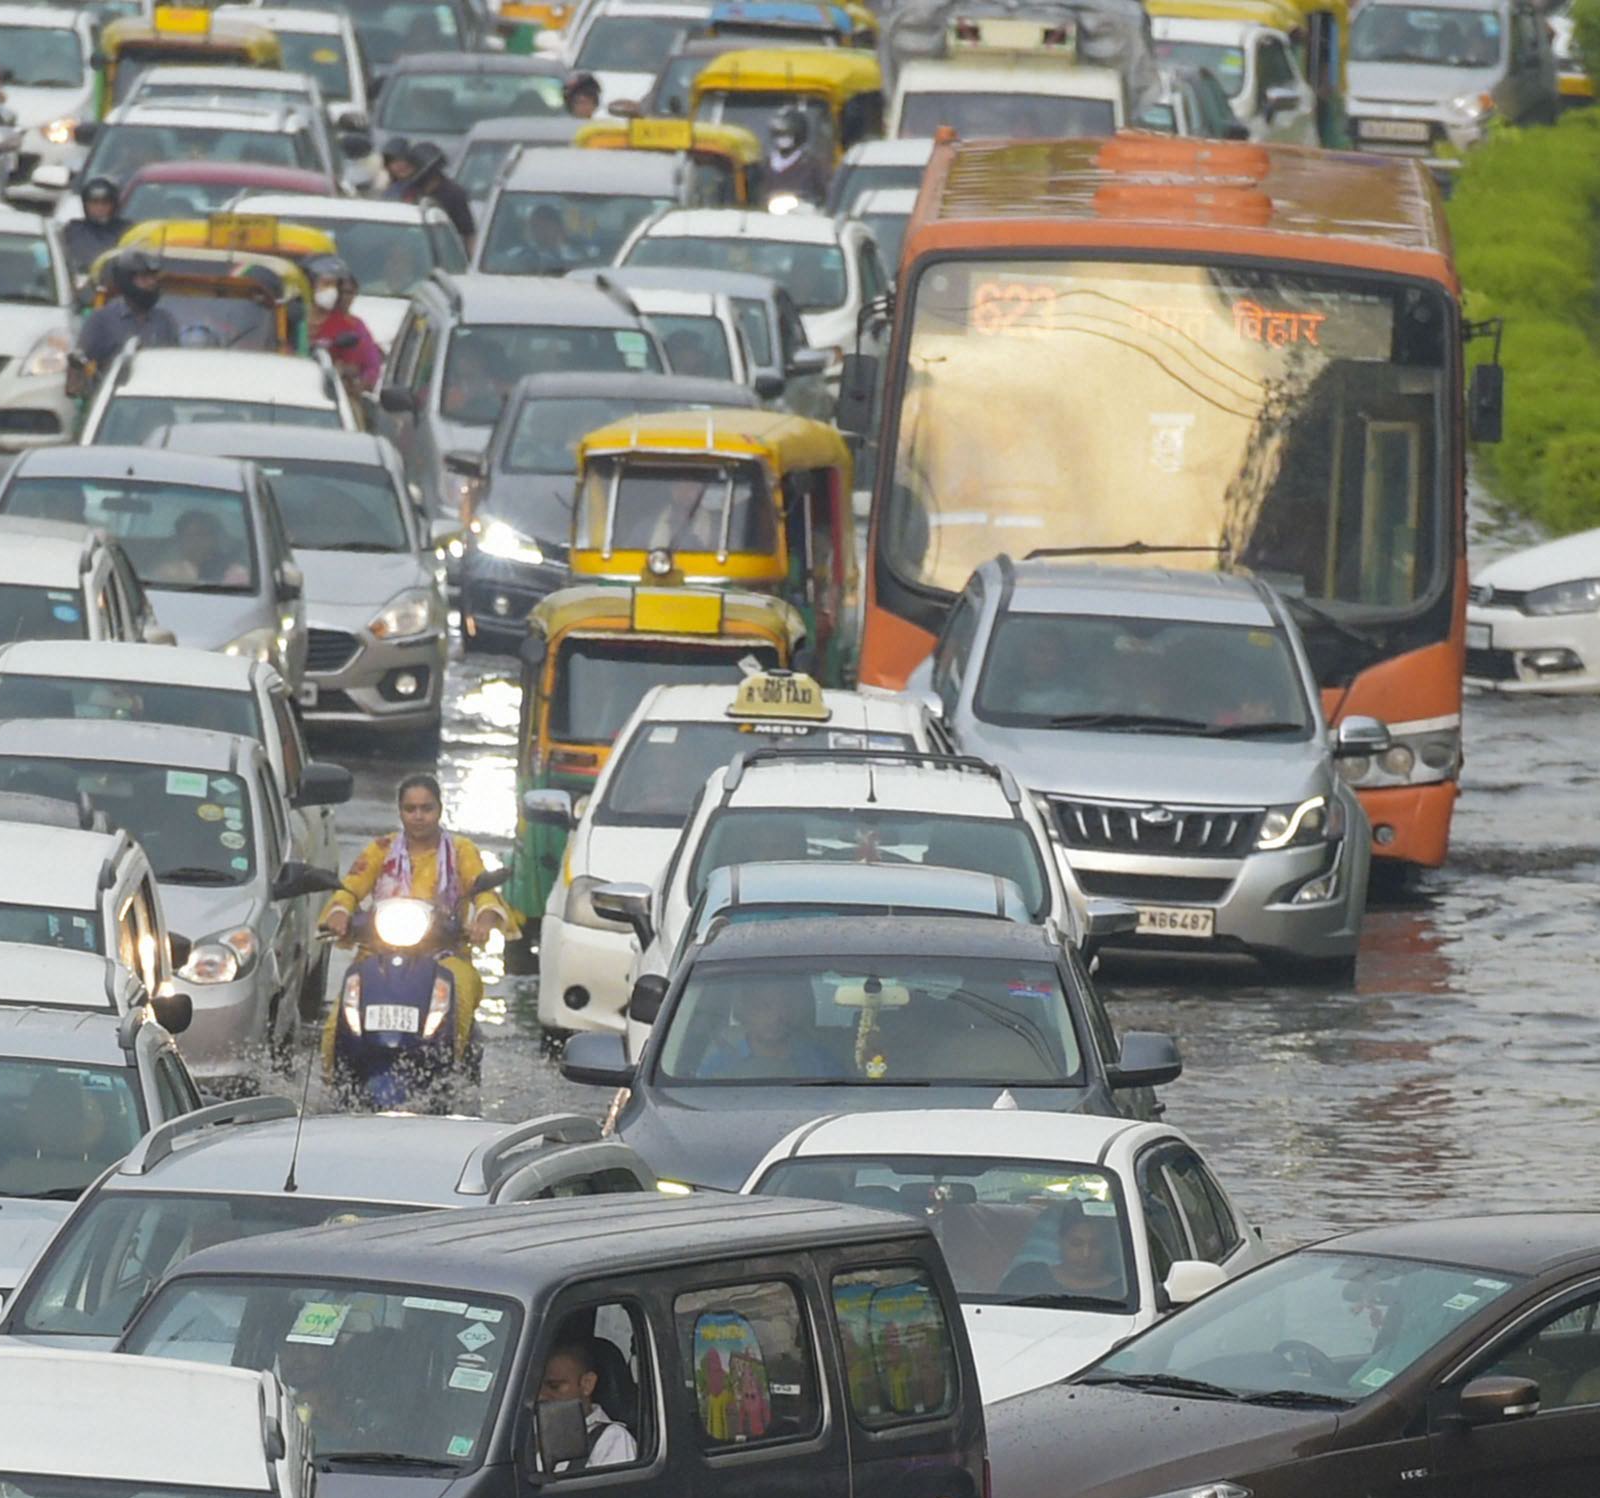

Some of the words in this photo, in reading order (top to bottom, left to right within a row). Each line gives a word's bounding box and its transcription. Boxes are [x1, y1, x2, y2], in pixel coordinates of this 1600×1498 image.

[1232, 297, 1326, 349] विहार
[754, 724, 809, 736] MERU
[464, 1331, 488, 1343] CNG
